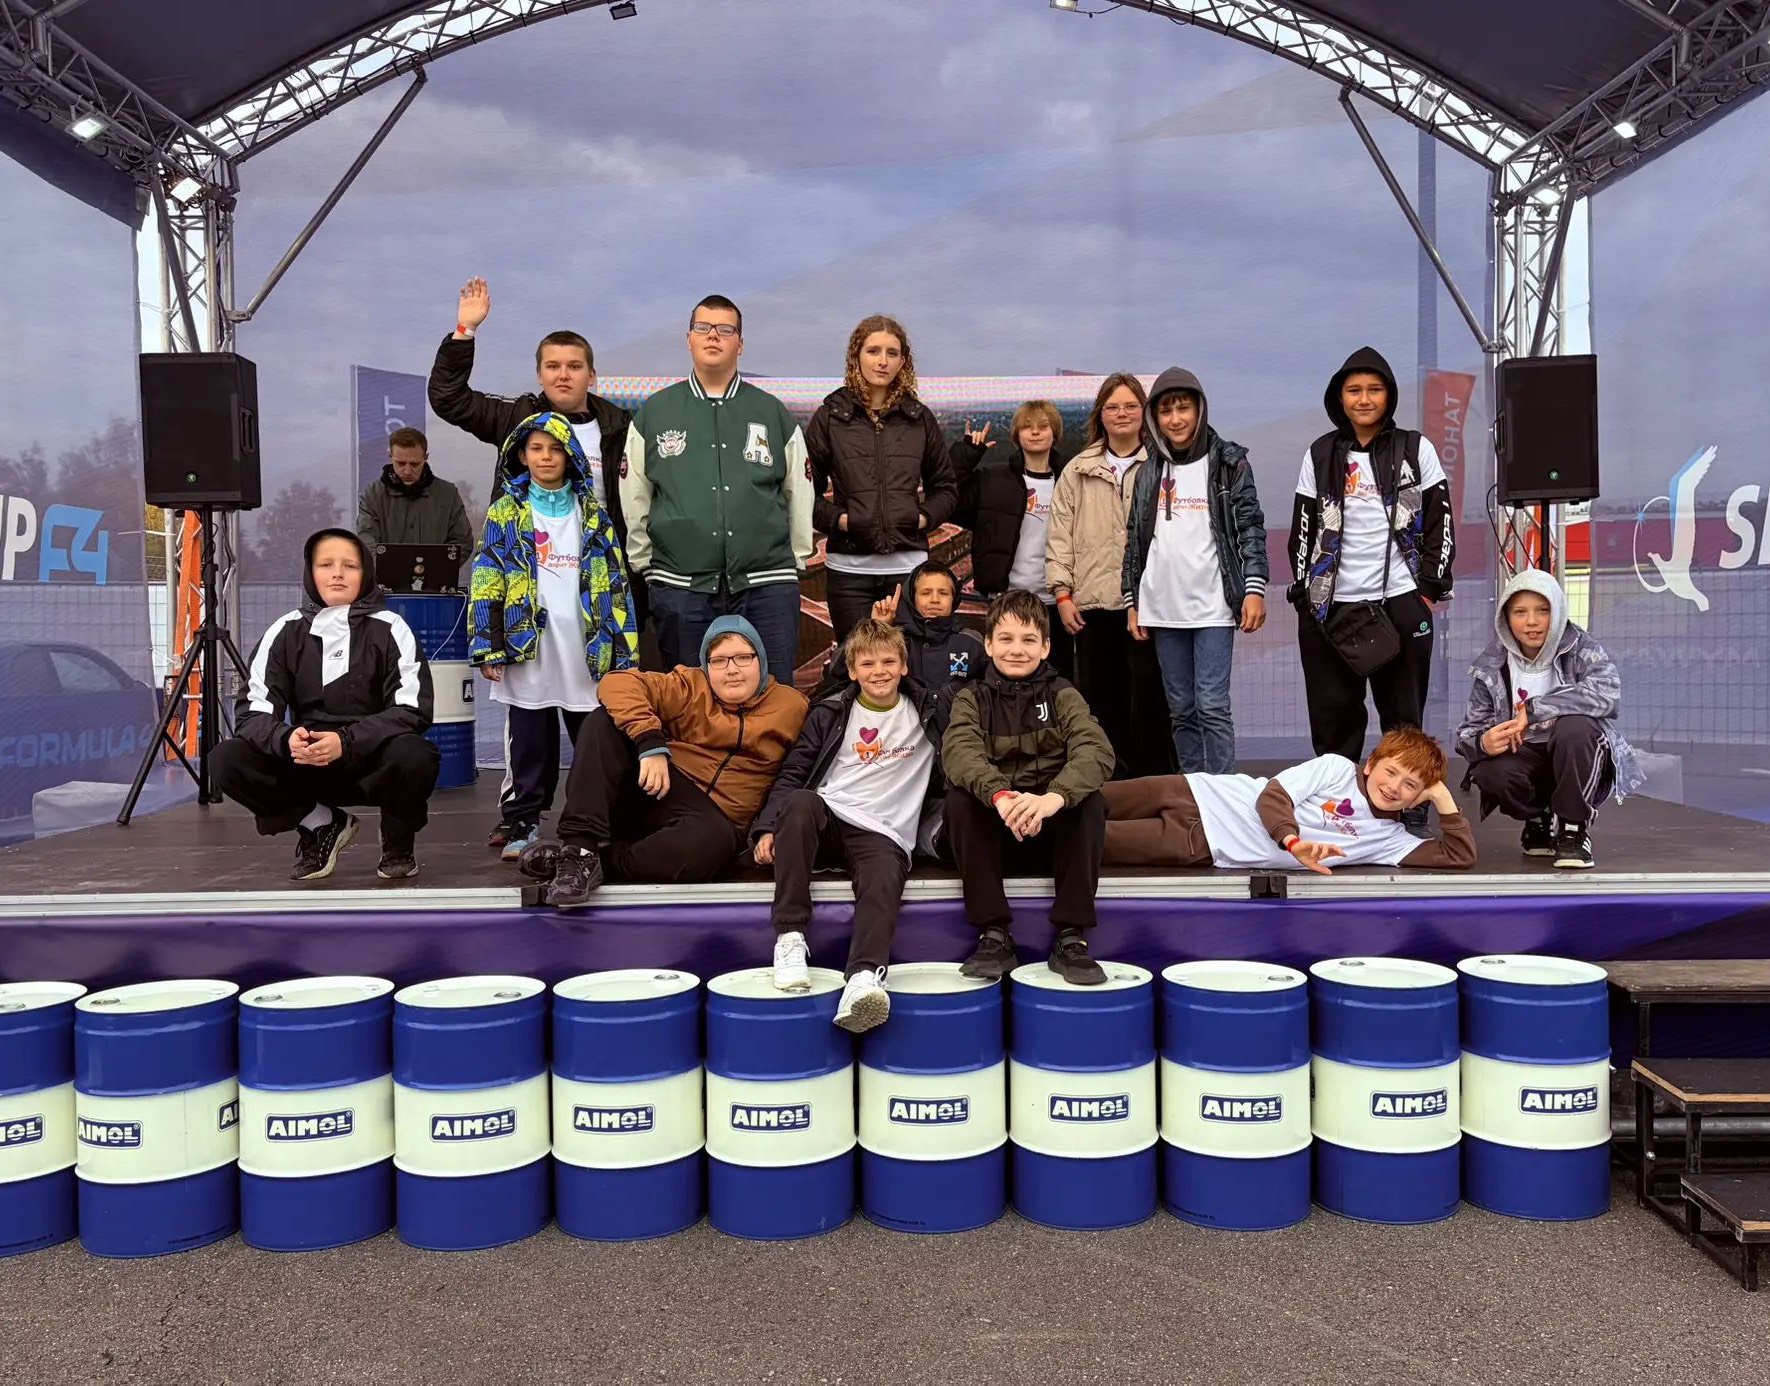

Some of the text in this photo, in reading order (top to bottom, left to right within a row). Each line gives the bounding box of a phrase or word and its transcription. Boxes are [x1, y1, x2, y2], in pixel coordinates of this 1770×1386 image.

[0, 494, 37, 580] P
[1051, 1099, 1127, 1118] AIMOL
[1203, 1099, 1280, 1119] AIMOL
[1373, 1094, 1446, 1114] AIMOL
[1522, 1090, 1597, 1110] AIMOL
[575, 1110, 652, 1129] AIMOL
[732, 1108, 808, 1127] AIMOL
[891, 1102, 967, 1120] AIMOL
[0, 1120, 41, 1142] OL
[268, 1114, 351, 1137] AIMOL
[433, 1113, 514, 1137] AIMOL
